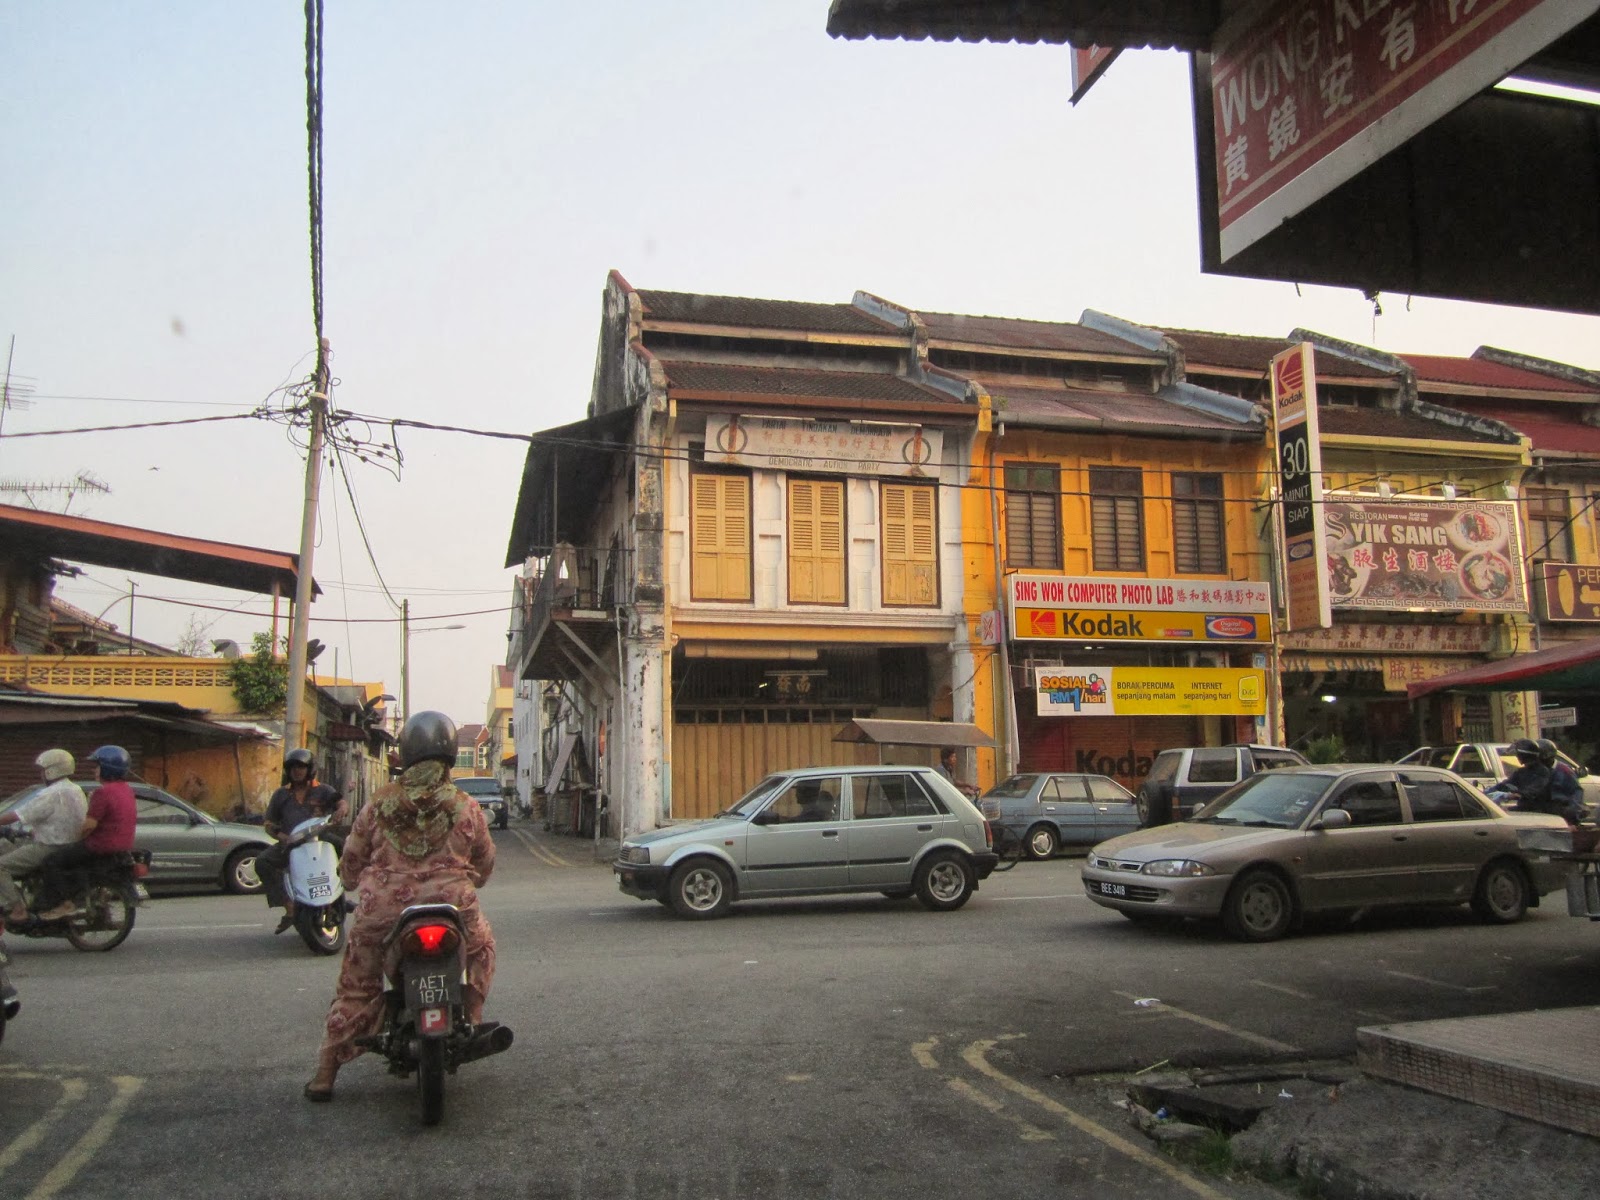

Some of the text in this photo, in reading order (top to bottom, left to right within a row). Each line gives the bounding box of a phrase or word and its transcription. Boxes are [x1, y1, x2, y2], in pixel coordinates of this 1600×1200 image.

[1220, 10, 1319, 136] WONG
[1279, 390, 1304, 409] Kodak
[769, 457, 813, 468] DEMOCRATIC
[858, 462, 880, 471] PARTY
[1283, 438, 1307, 480] 30
[1285, 484, 1309, 502] MINIT
[1288, 507, 1309, 523] SIAP
[1350, 511, 1387, 521] RESTORAN
[1391, 524, 1447, 546] SANG
[1015, 581, 1173, 605] SING WOH COMPUTER PHOTO LAB
[1062, 612, 1144, 636] Kodak
[1220, 621, 1241, 629] Digital
[1041, 676, 1089, 689] SOSIAL
[1191, 682, 1222, 690] INTERNET
[1075, 749, 1160, 777] Koda
[420, 975, 446, 990] AET
[420, 988, 449, 1003] 1871
[425, 1009, 441, 1028] P
